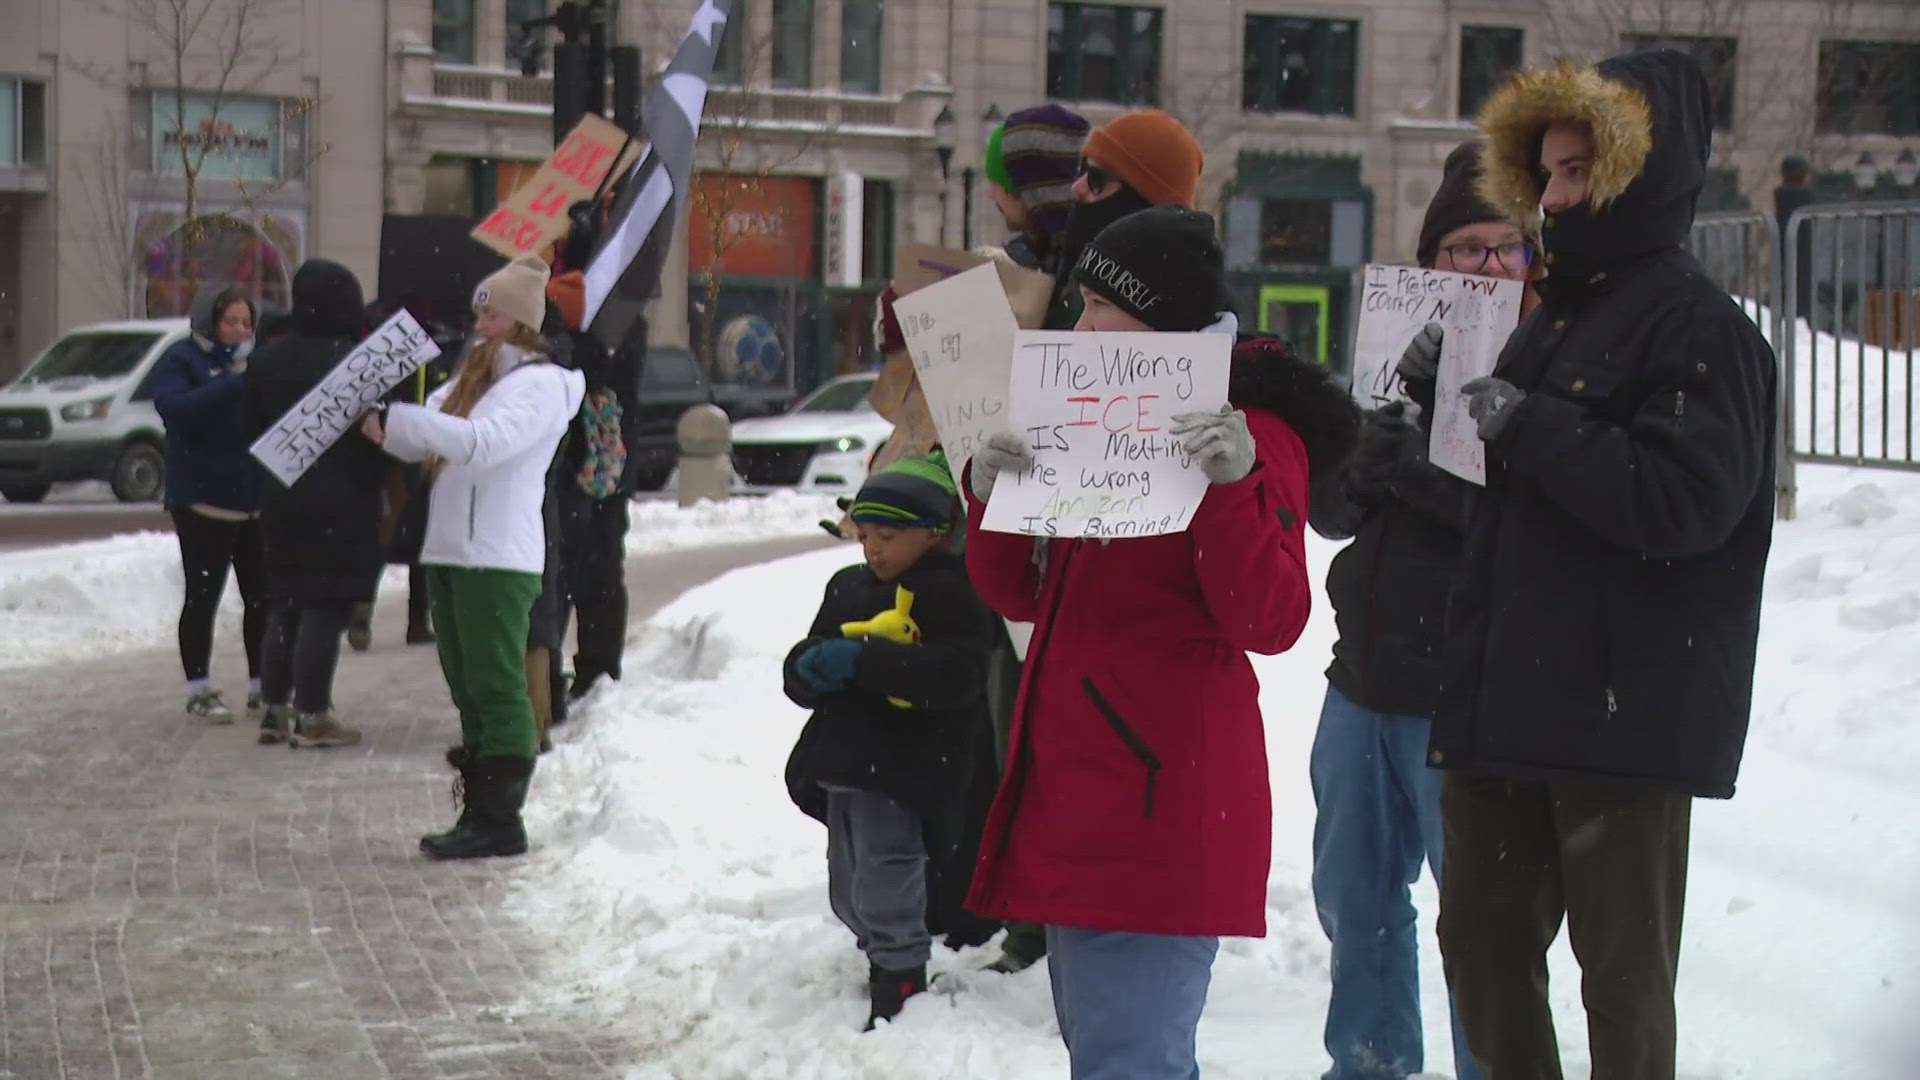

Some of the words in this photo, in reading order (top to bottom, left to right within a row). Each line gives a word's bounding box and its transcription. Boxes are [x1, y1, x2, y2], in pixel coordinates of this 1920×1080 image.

[1093, 253, 1162, 310] YOURSELF
[1368, 266, 1388, 289] I
[268, 376, 342, 451] ICE
[347, 316, 408, 373] OUT
[1022, 343, 1097, 390] The
[1100, 345, 1193, 400] Wrong
[286, 355, 422, 473] WELCOME
[1066, 395, 1161, 433] ICE
[1027, 425, 1070, 451] IS
[1019, 516, 1057, 535] IS
[1083, 506, 1187, 536] Burning!
[1038, 488, 1144, 517] Amzon
